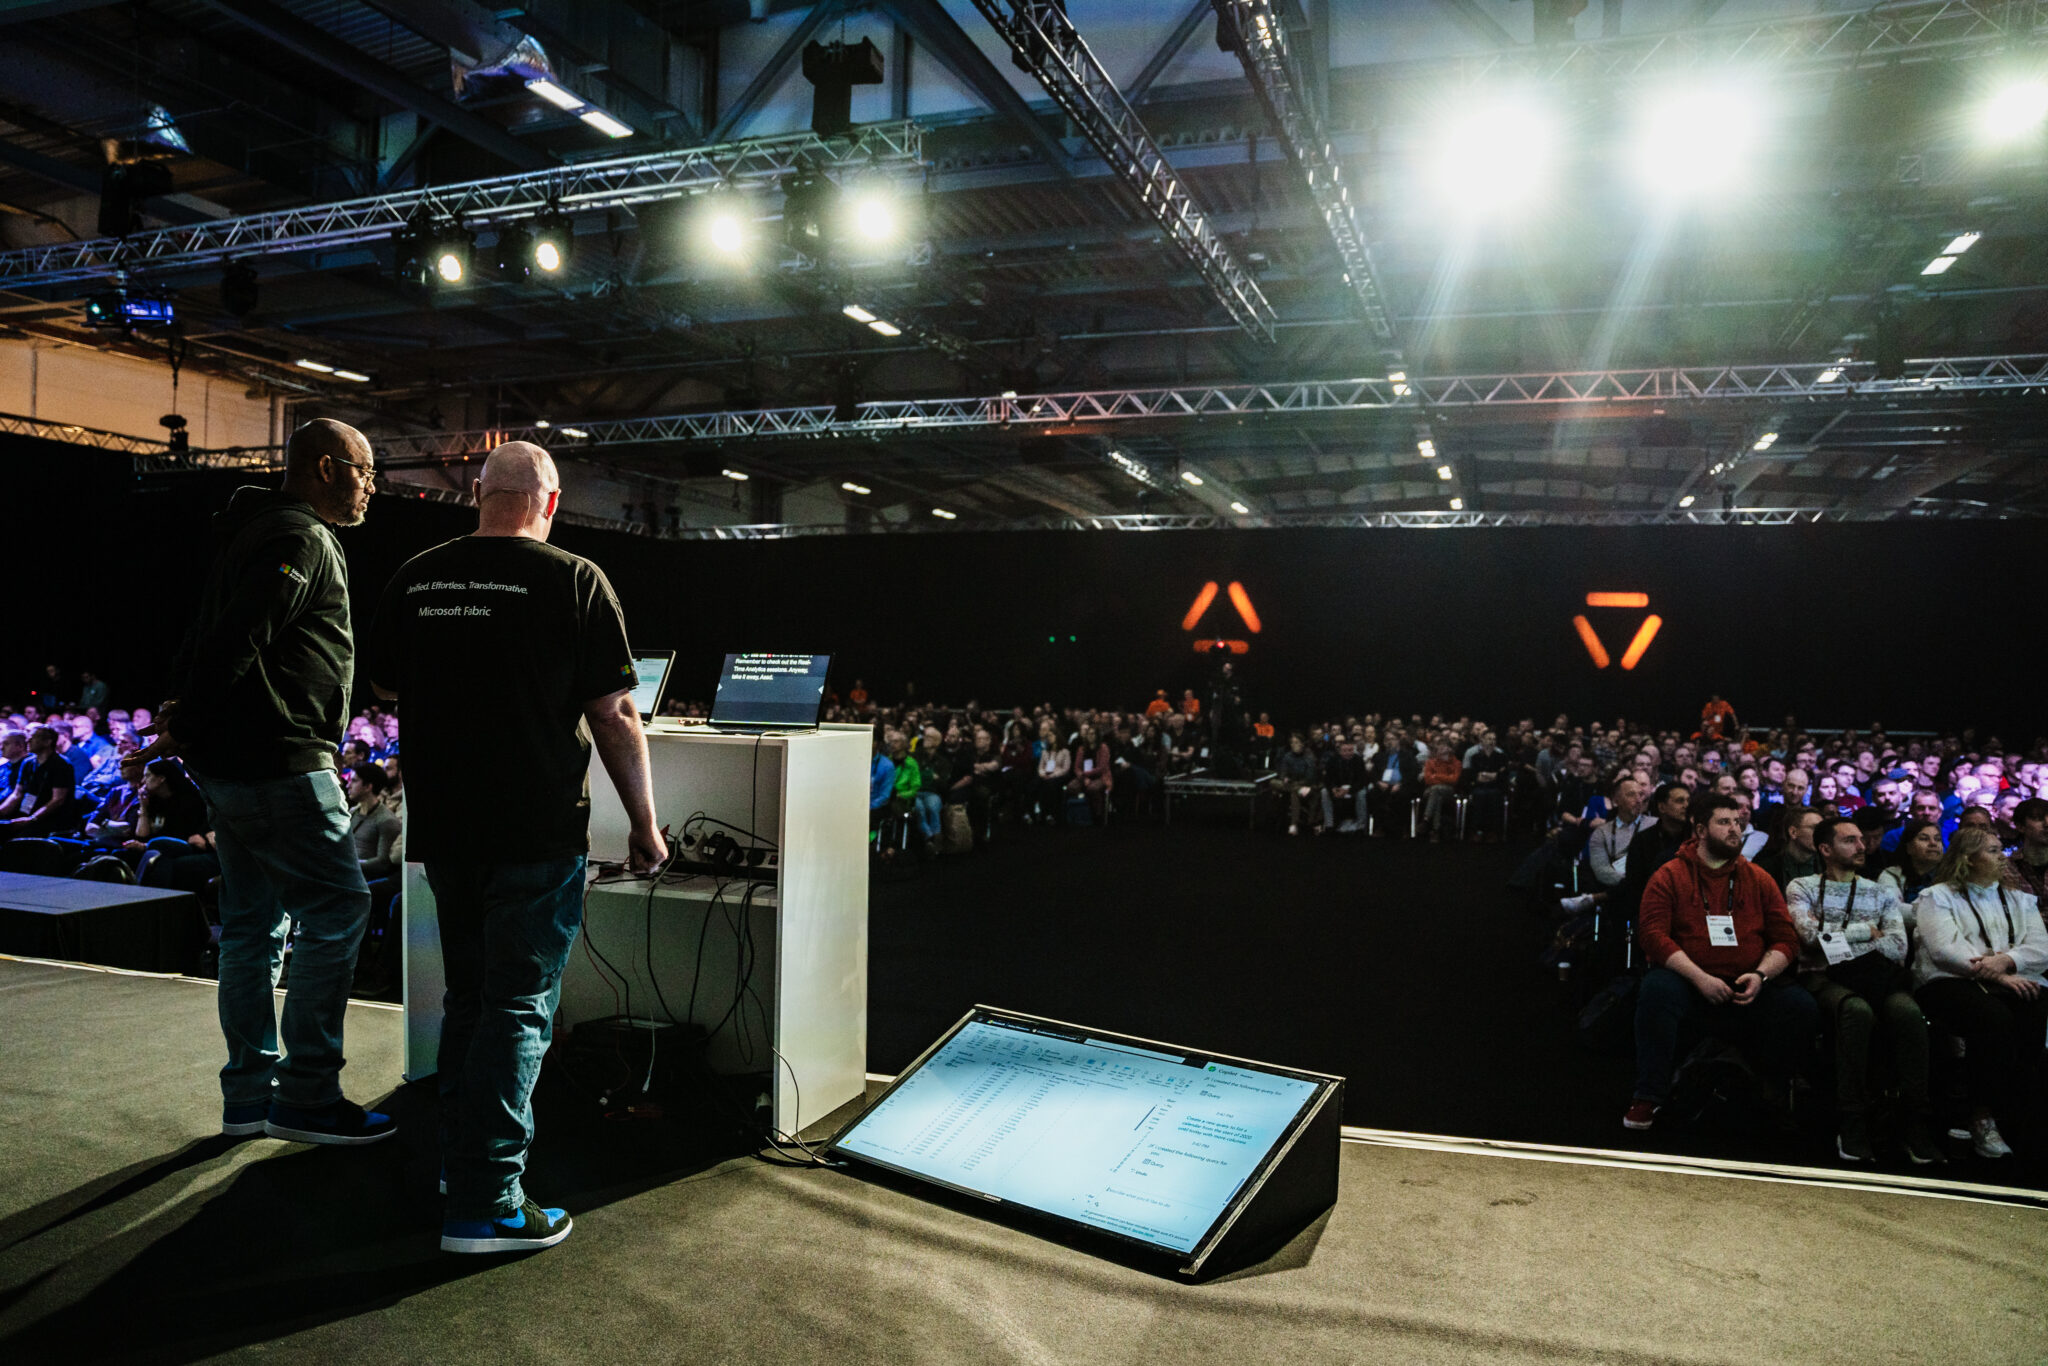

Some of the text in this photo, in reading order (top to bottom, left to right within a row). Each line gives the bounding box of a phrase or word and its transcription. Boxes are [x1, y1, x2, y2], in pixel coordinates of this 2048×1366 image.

[431, 581, 467, 590] Effortless.
[468, 581, 528, 594] Transformative.
[418, 606, 491, 616] Microsoft Fabric
